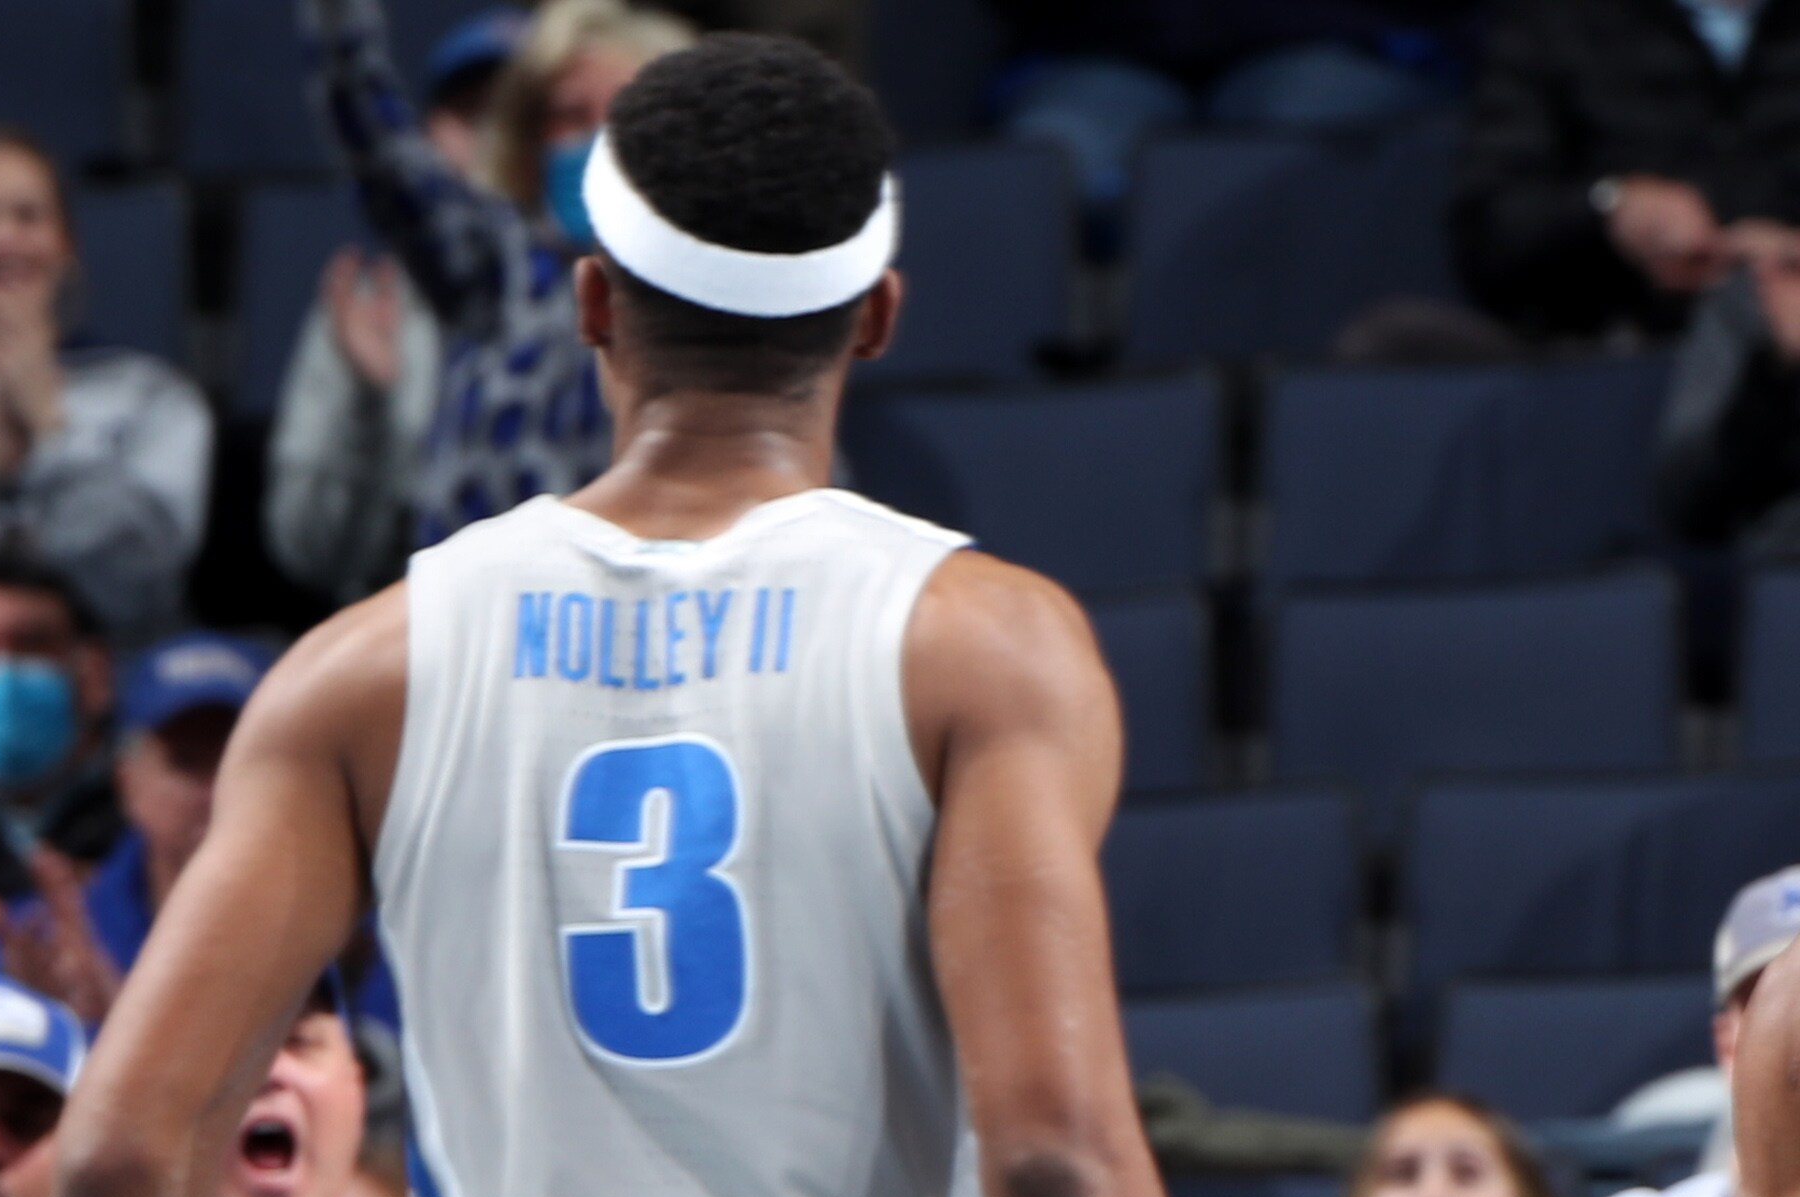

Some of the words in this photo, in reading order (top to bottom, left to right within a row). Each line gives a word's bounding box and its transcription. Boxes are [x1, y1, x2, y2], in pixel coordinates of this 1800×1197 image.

[513, 588, 731, 689] NOLLEY
[748, 587, 794, 673] II
[557, 732, 752, 1070] 3
